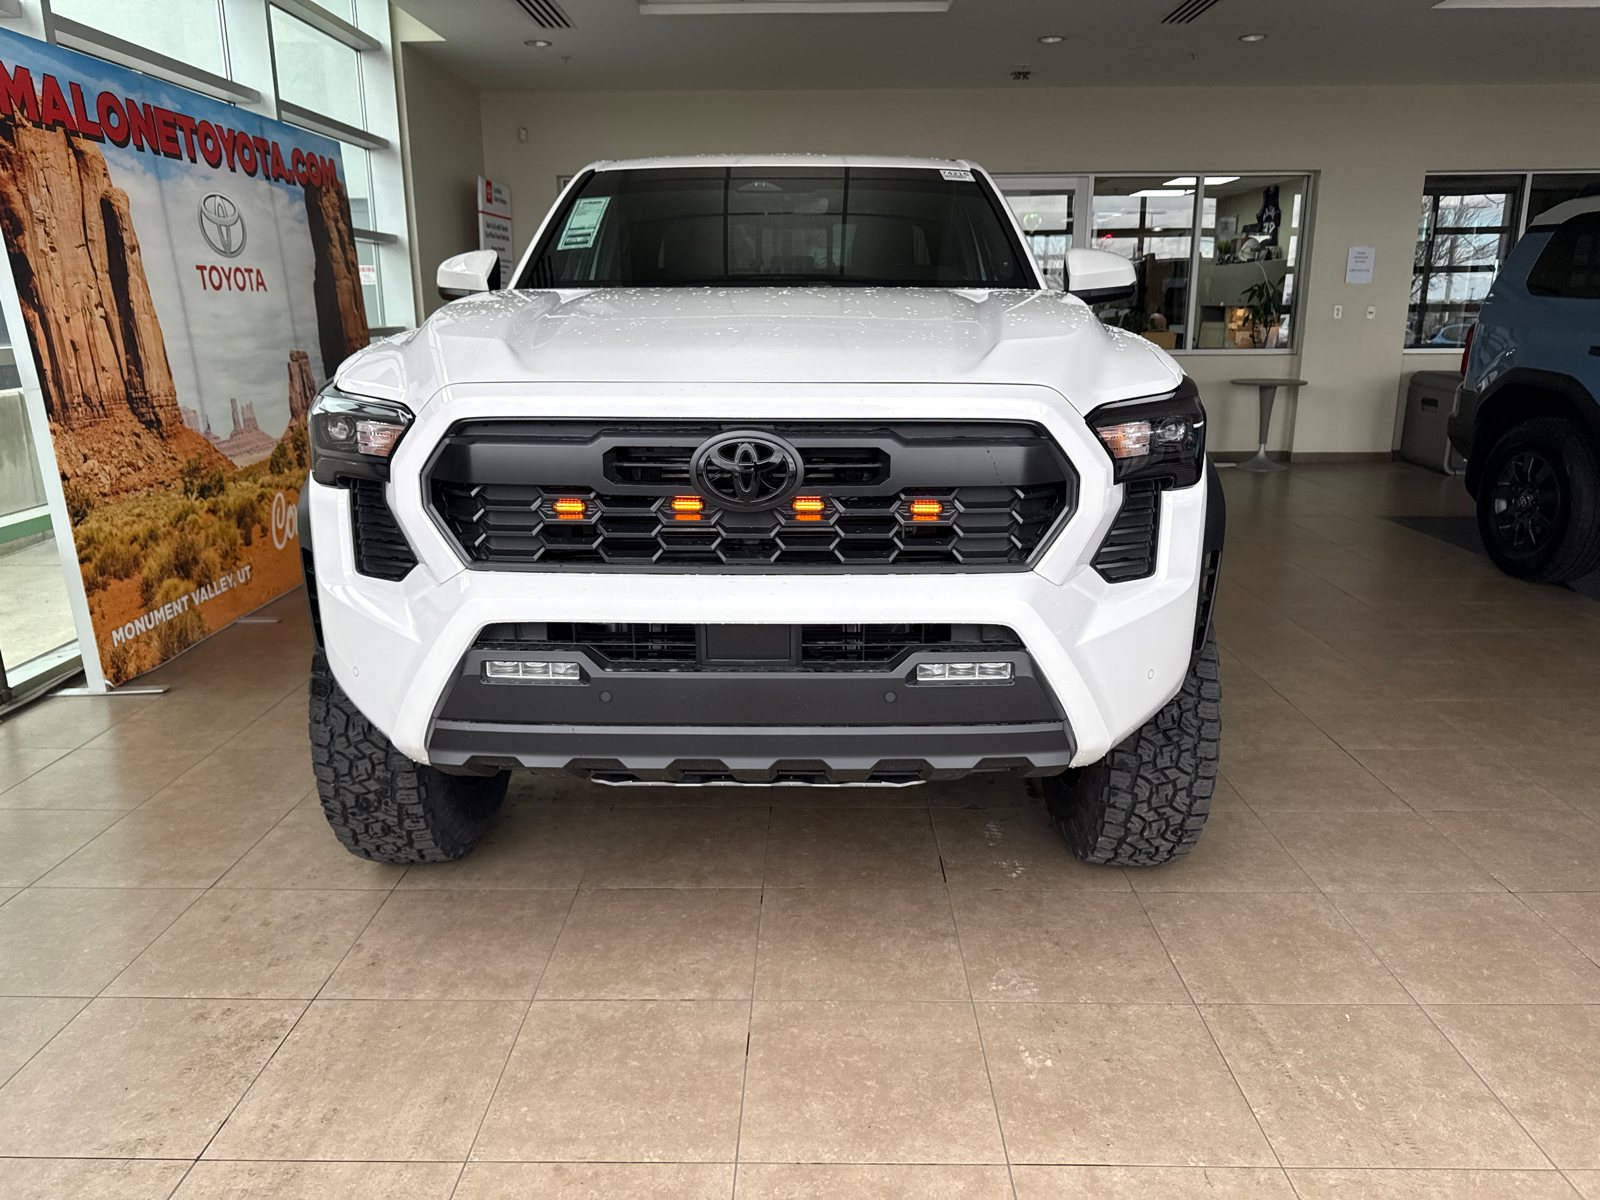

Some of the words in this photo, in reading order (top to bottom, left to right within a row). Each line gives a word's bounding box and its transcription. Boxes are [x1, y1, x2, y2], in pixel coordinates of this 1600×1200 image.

[0, 61, 339, 192] MALONETOYOTA.COM
[196, 264, 268, 292] TOYOTA
[111, 595, 190, 647] MONUMENT
[191, 573, 238, 605] VALLEY,
[238, 565, 252, 584] UT
